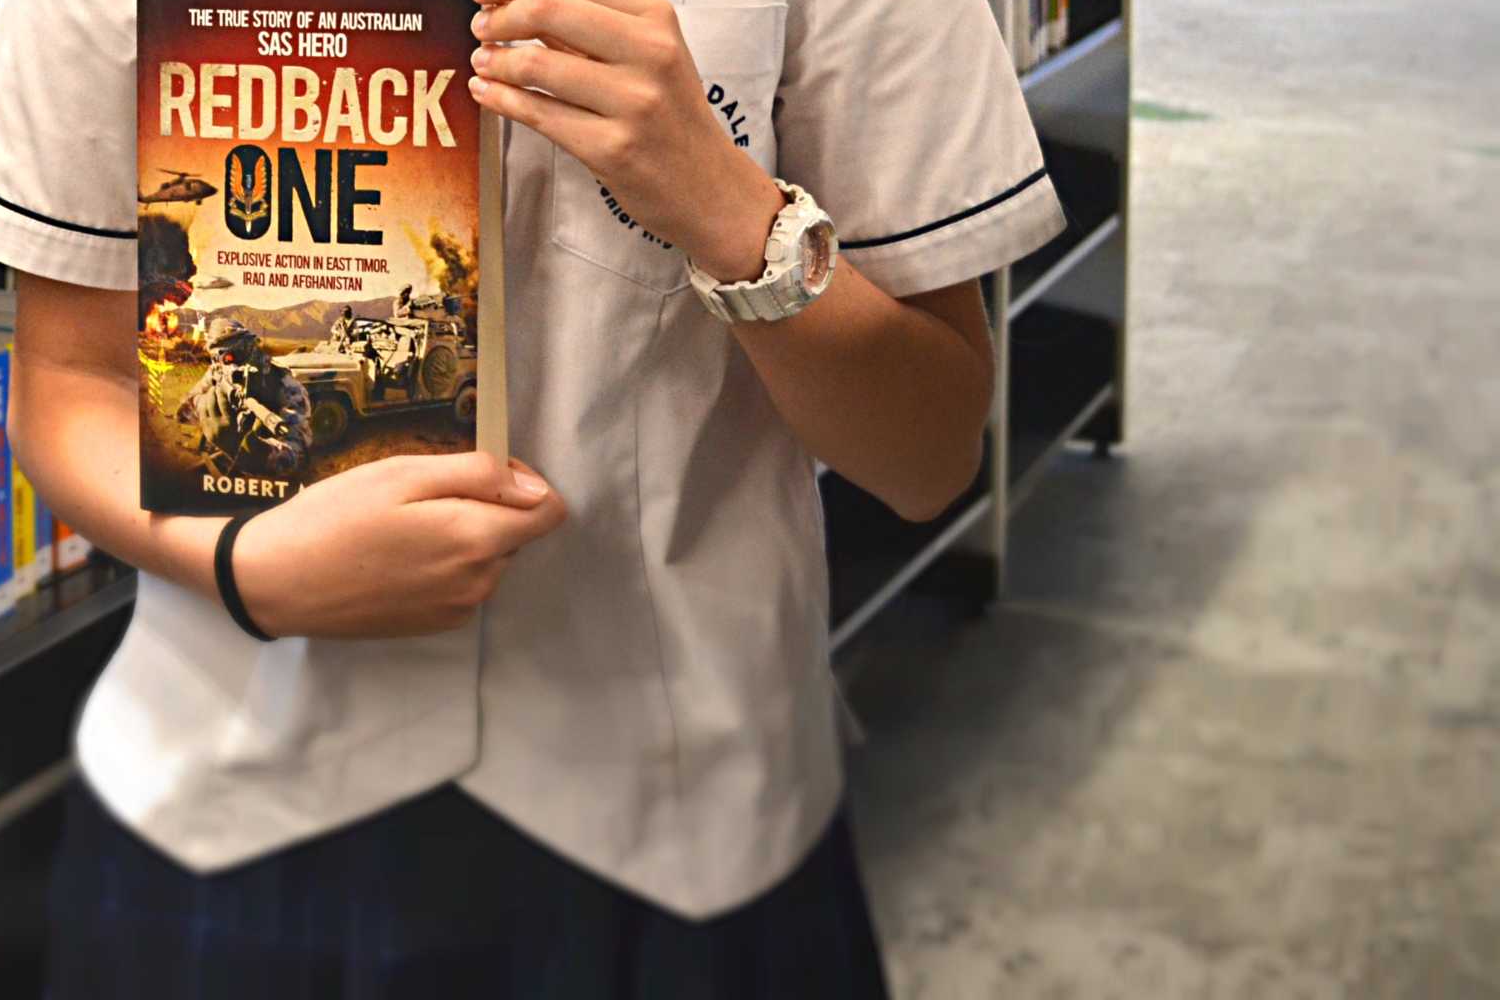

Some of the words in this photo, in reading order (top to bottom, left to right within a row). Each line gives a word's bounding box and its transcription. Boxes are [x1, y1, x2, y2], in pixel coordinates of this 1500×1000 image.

[188, 8, 213, 26] THE
[216, 9, 249, 28] TRUE
[252, 10, 293, 28] STORY
[296, 11, 314, 29] OF
[318, 12, 337, 29] AN
[340, 12, 423, 31] AUSTRALIAN
[257, 31, 293, 56] SAS
[298, 32, 348, 58] HERO
[159, 61, 457, 147] REDBACK
[224, 143, 389, 246] ONE
[217, 250, 272, 268] EXPLOSIVE
[274, 254, 310, 270] ACTION
[313, 256, 324, 270] IN
[326, 257, 353, 271] EAST
[354, 258, 390, 274] TIMOR,
[243, 271, 265, 287] IRAQ
[268, 273, 289, 288] AND
[292, 274, 363, 291] AFGHANISTAN
[202, 474, 289, 499] ROBERT
